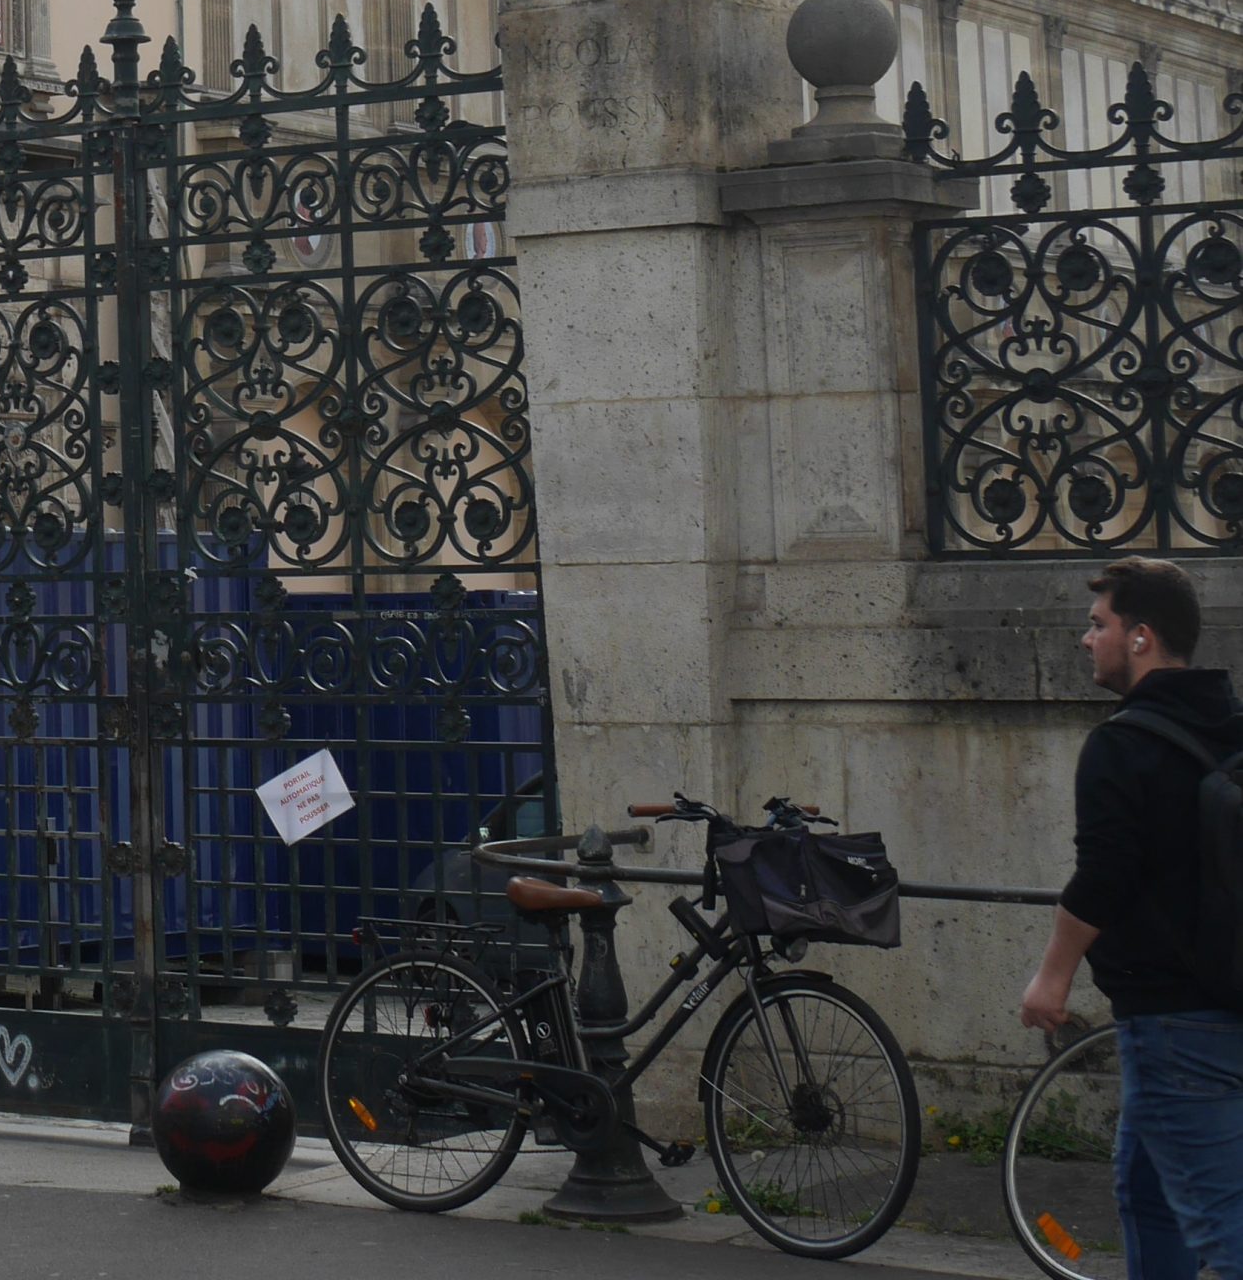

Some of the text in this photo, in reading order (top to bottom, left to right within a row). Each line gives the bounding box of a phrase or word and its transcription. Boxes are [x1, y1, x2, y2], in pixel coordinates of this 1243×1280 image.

[523, 32, 660, 72] NICOLAS
[520, 92, 674, 133] POUSSIN
[279, 774, 326, 807] AUTOMATIQUE
[283, 770, 311, 790] PORTAIL
[296, 793, 321, 811] NE PAS
[299, 802, 331, 825] POUSSER
